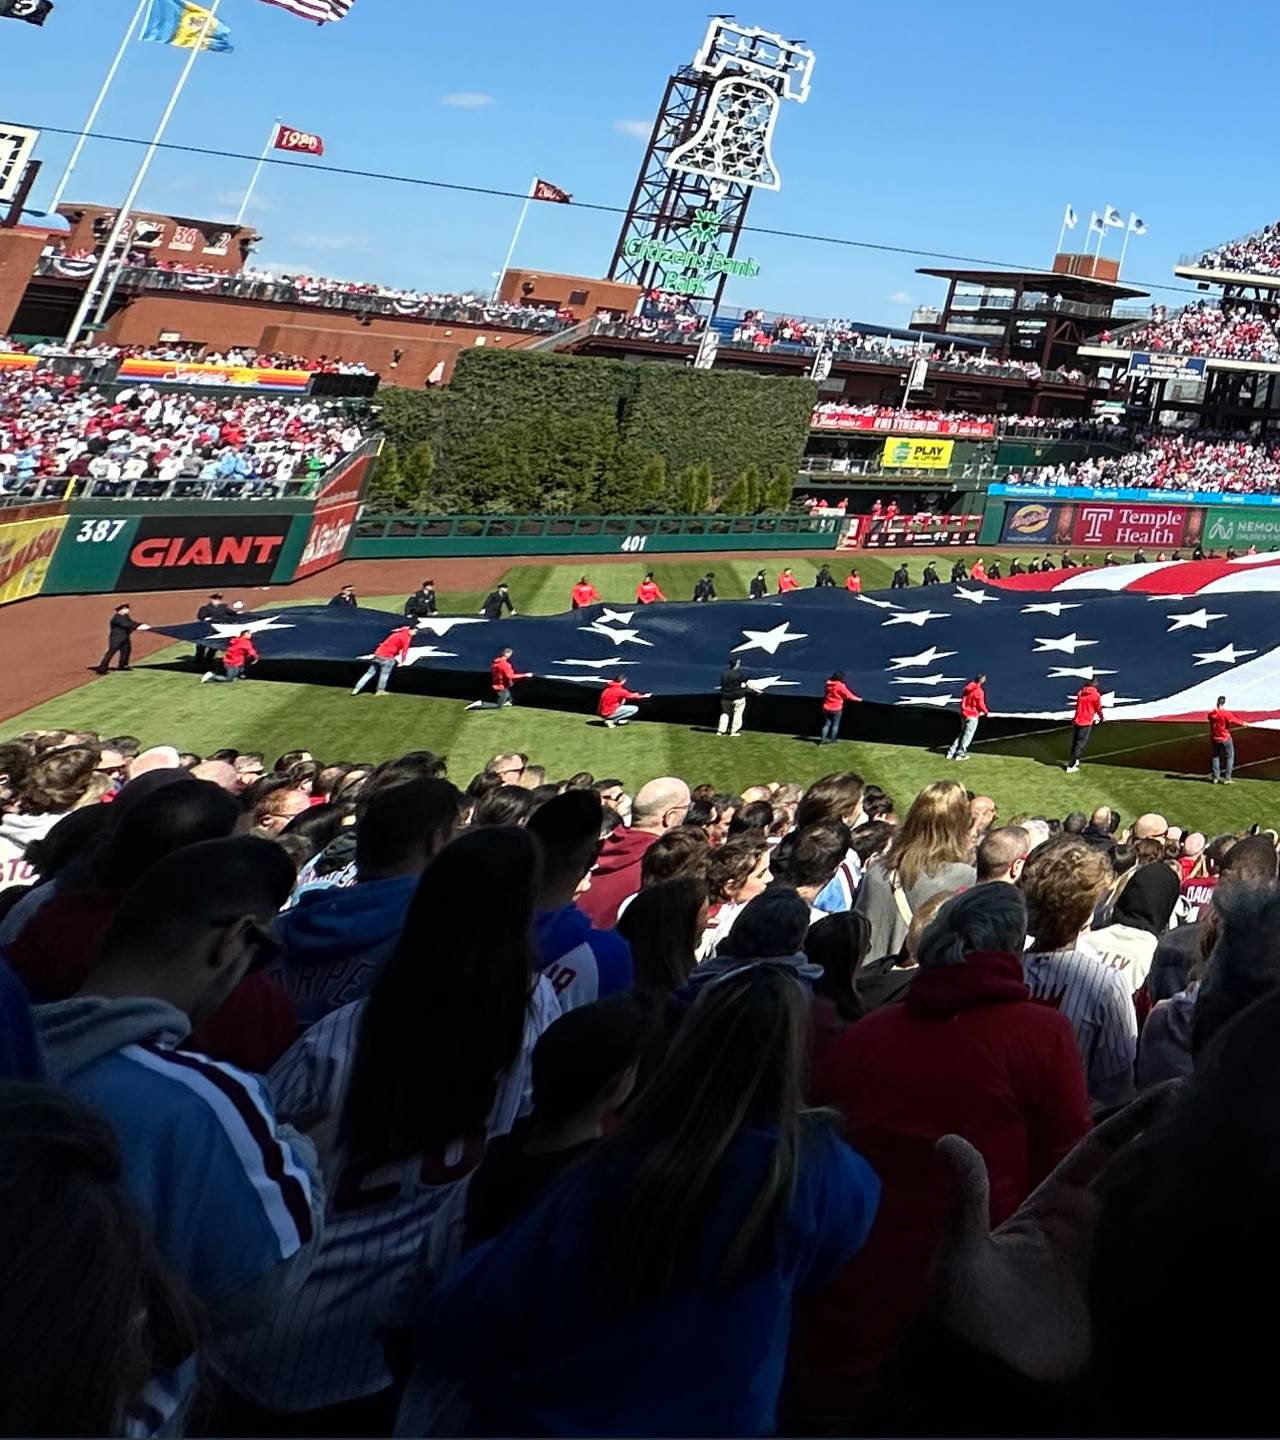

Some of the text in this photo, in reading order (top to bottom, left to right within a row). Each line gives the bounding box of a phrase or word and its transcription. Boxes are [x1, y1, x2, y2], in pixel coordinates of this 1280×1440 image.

[281, 130, 318, 150] 1980
[623, 237, 760, 278] Citizens Bank
[664, 270, 706, 295] Park
[914, 445, 944, 456] PLAY
[1118, 509, 1182, 529] Temple
[76, 519, 127, 542] 387
[1116, 528, 1174, 544] Health
[130, 536, 284, 567] GIANT
[621, 535, 648, 551] 401
